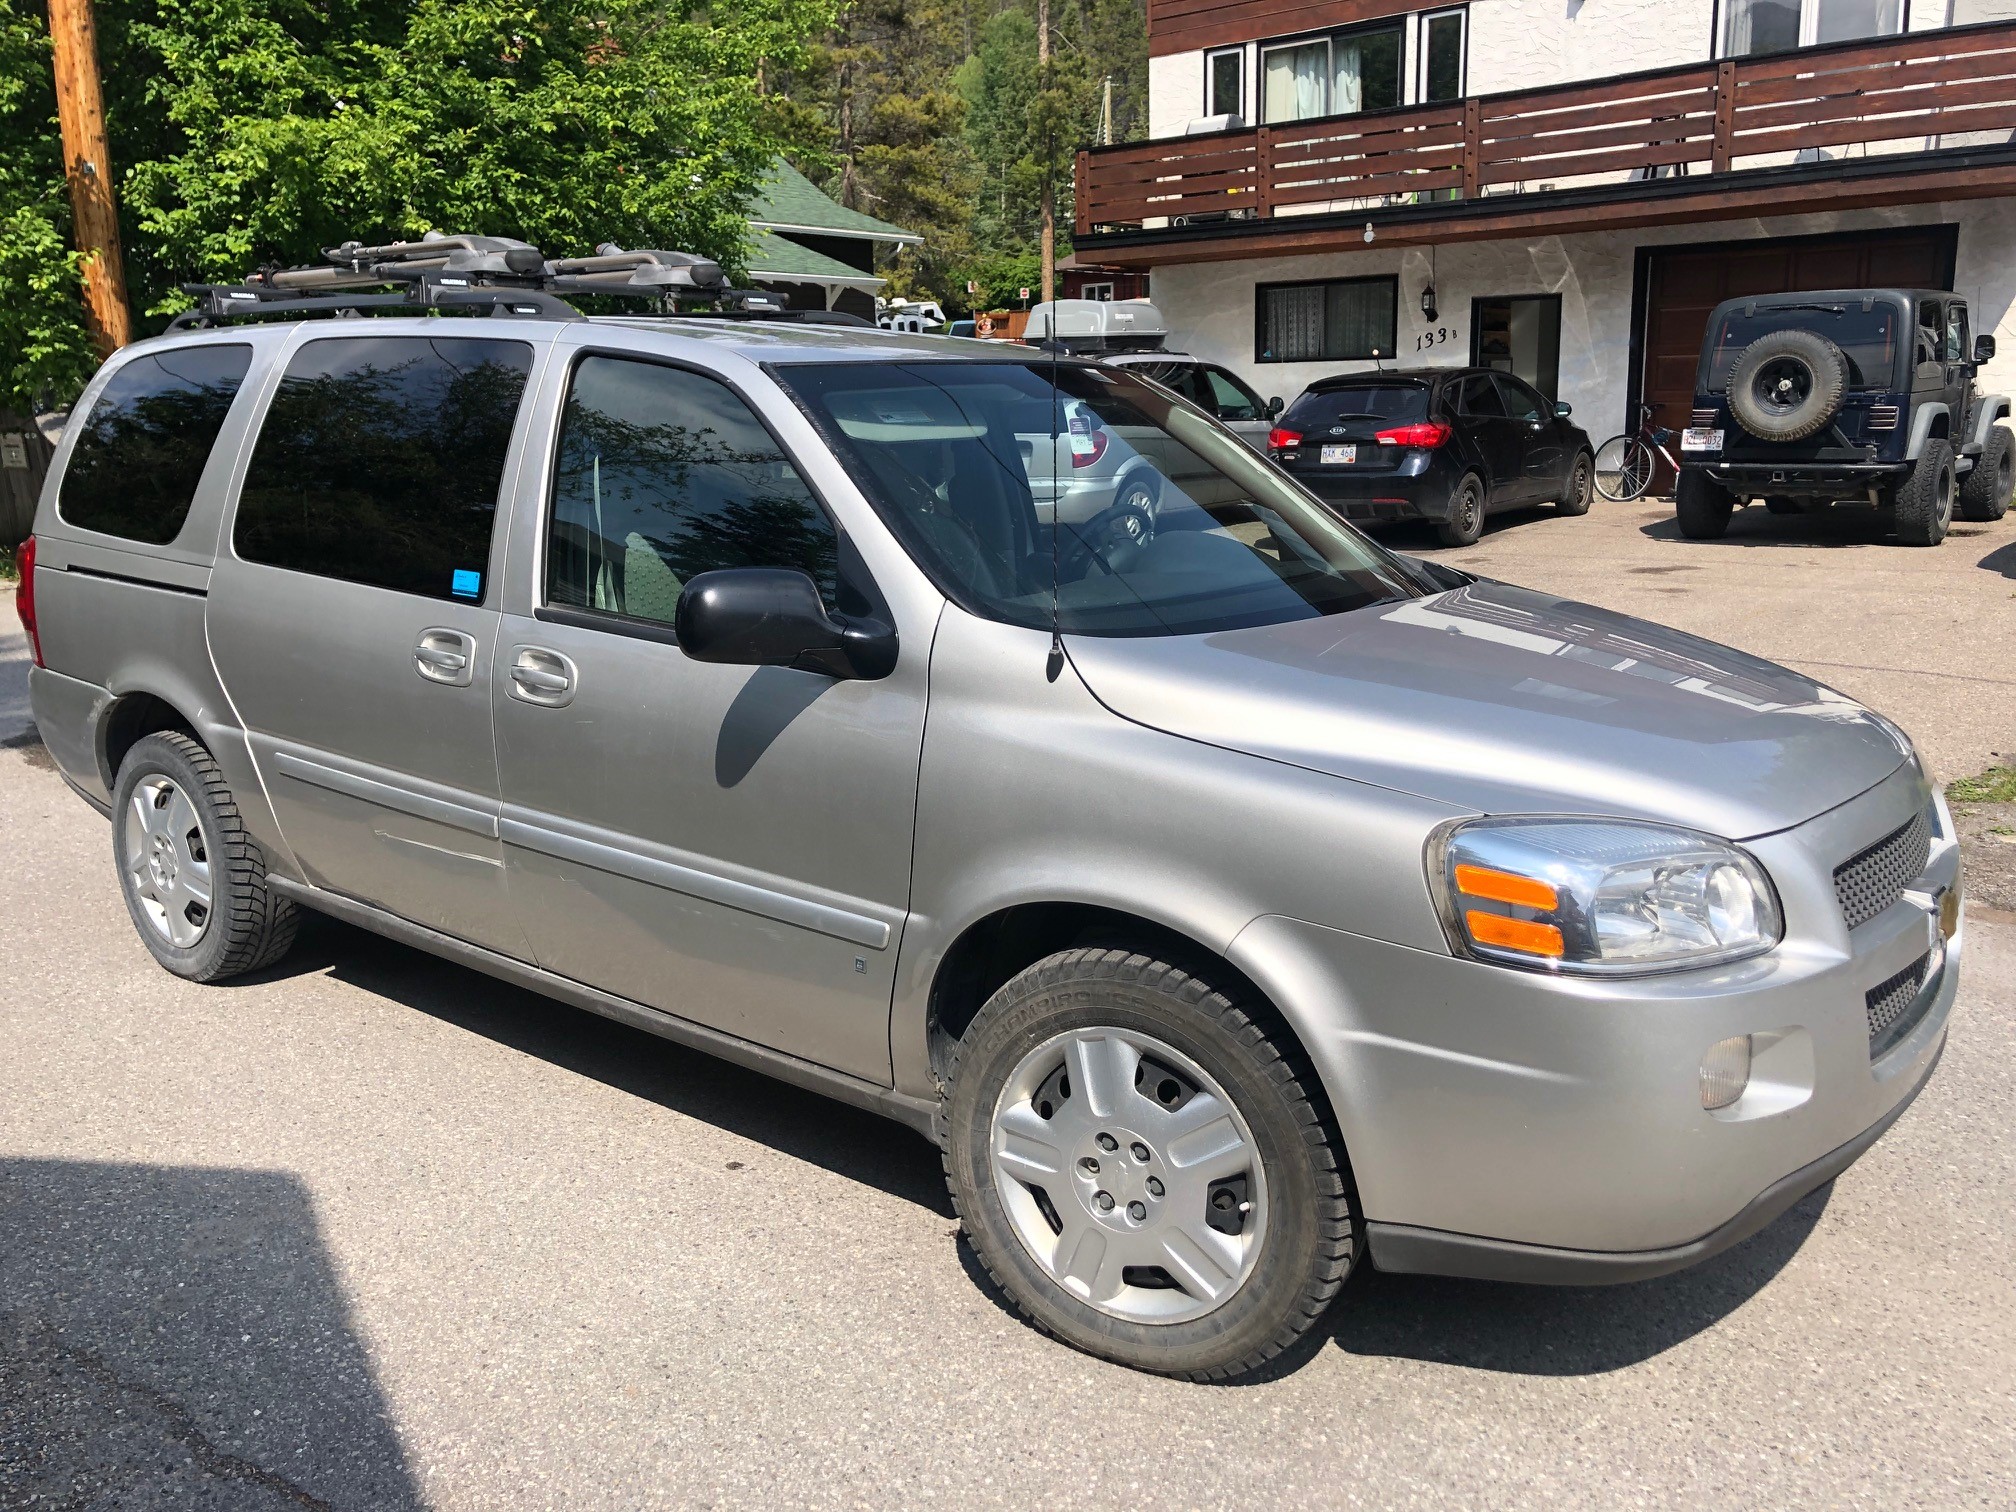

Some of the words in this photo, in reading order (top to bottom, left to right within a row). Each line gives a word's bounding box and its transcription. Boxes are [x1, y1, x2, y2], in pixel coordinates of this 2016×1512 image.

[1416, 327, 1447, 352] 133
[1452, 329, 1458, 339] B
[984, 991, 1091, 1053] CHAMPIRO
